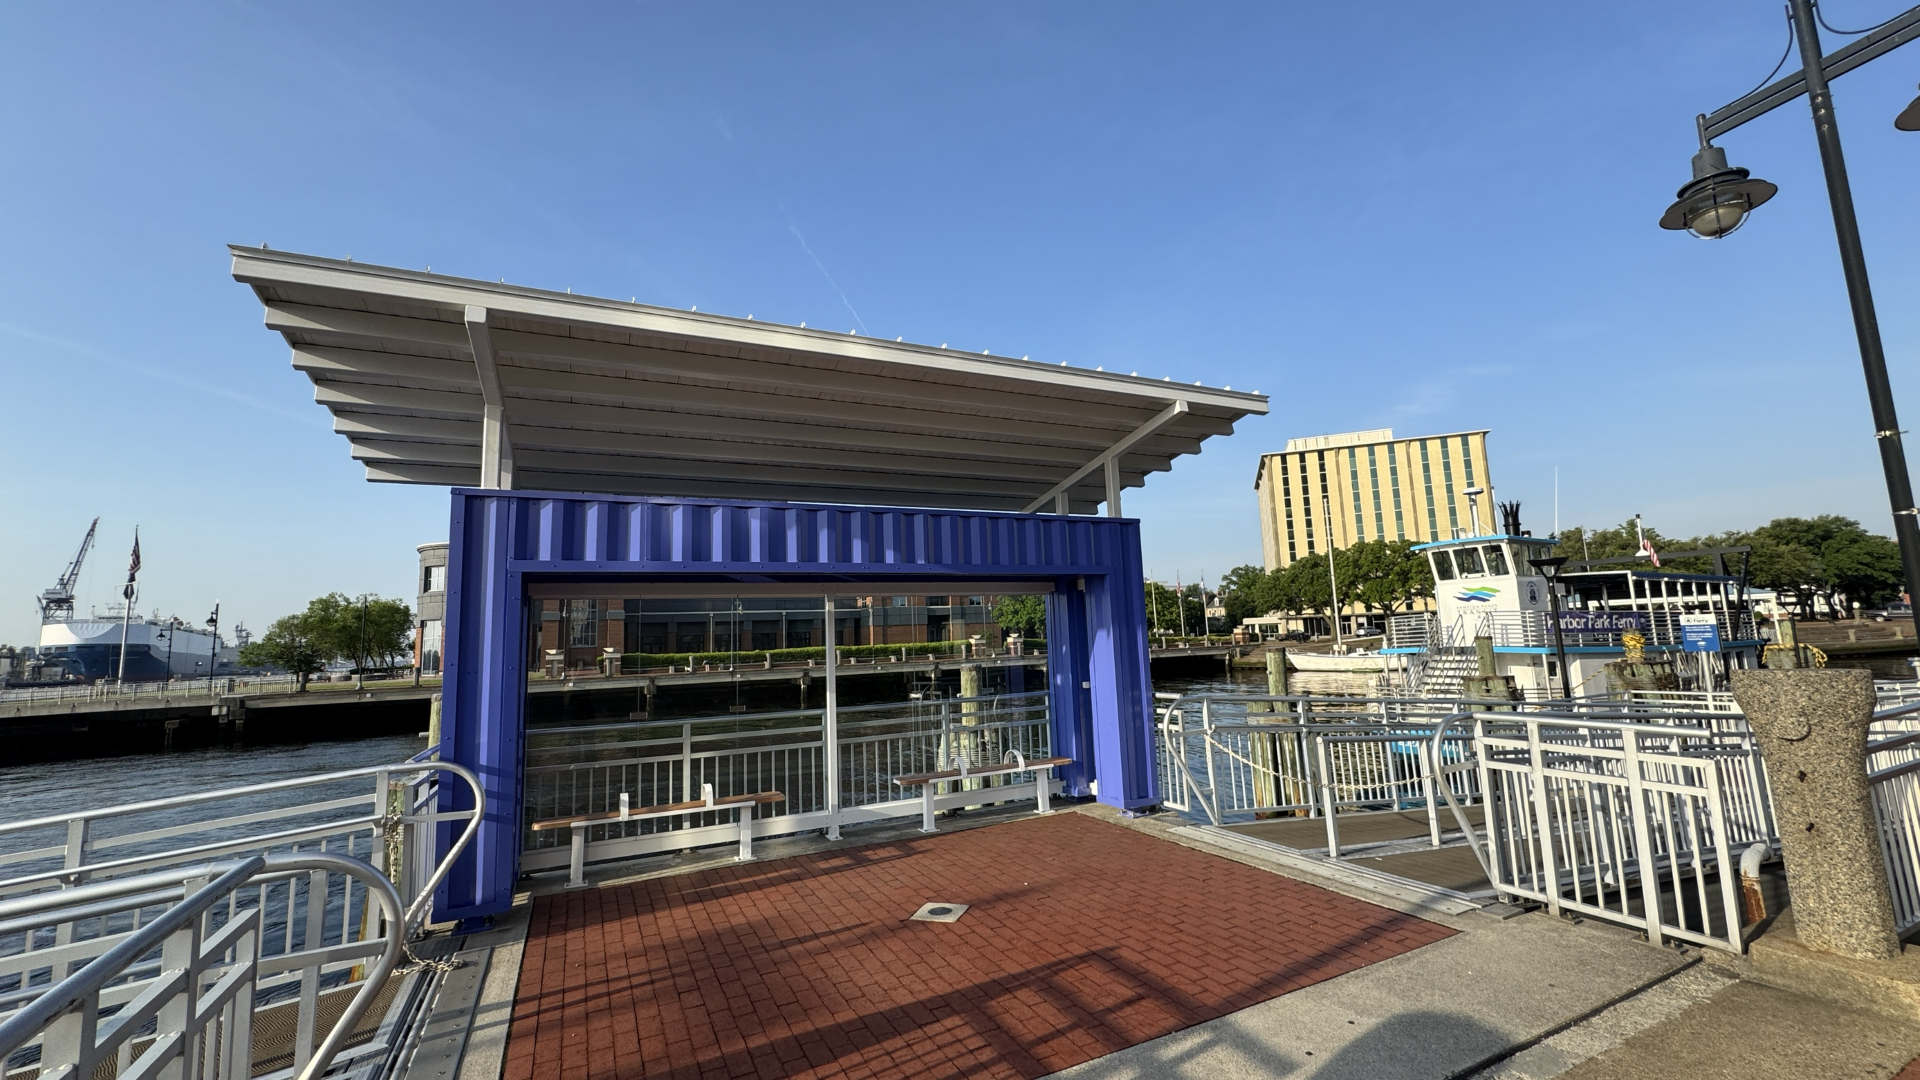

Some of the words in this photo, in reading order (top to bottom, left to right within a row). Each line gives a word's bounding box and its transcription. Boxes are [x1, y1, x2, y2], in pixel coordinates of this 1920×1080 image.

[1547, 614, 1587, 629] Harbor
[1588, 614, 1611, 629] Park
[1612, 614, 1637, 630] Ferry
